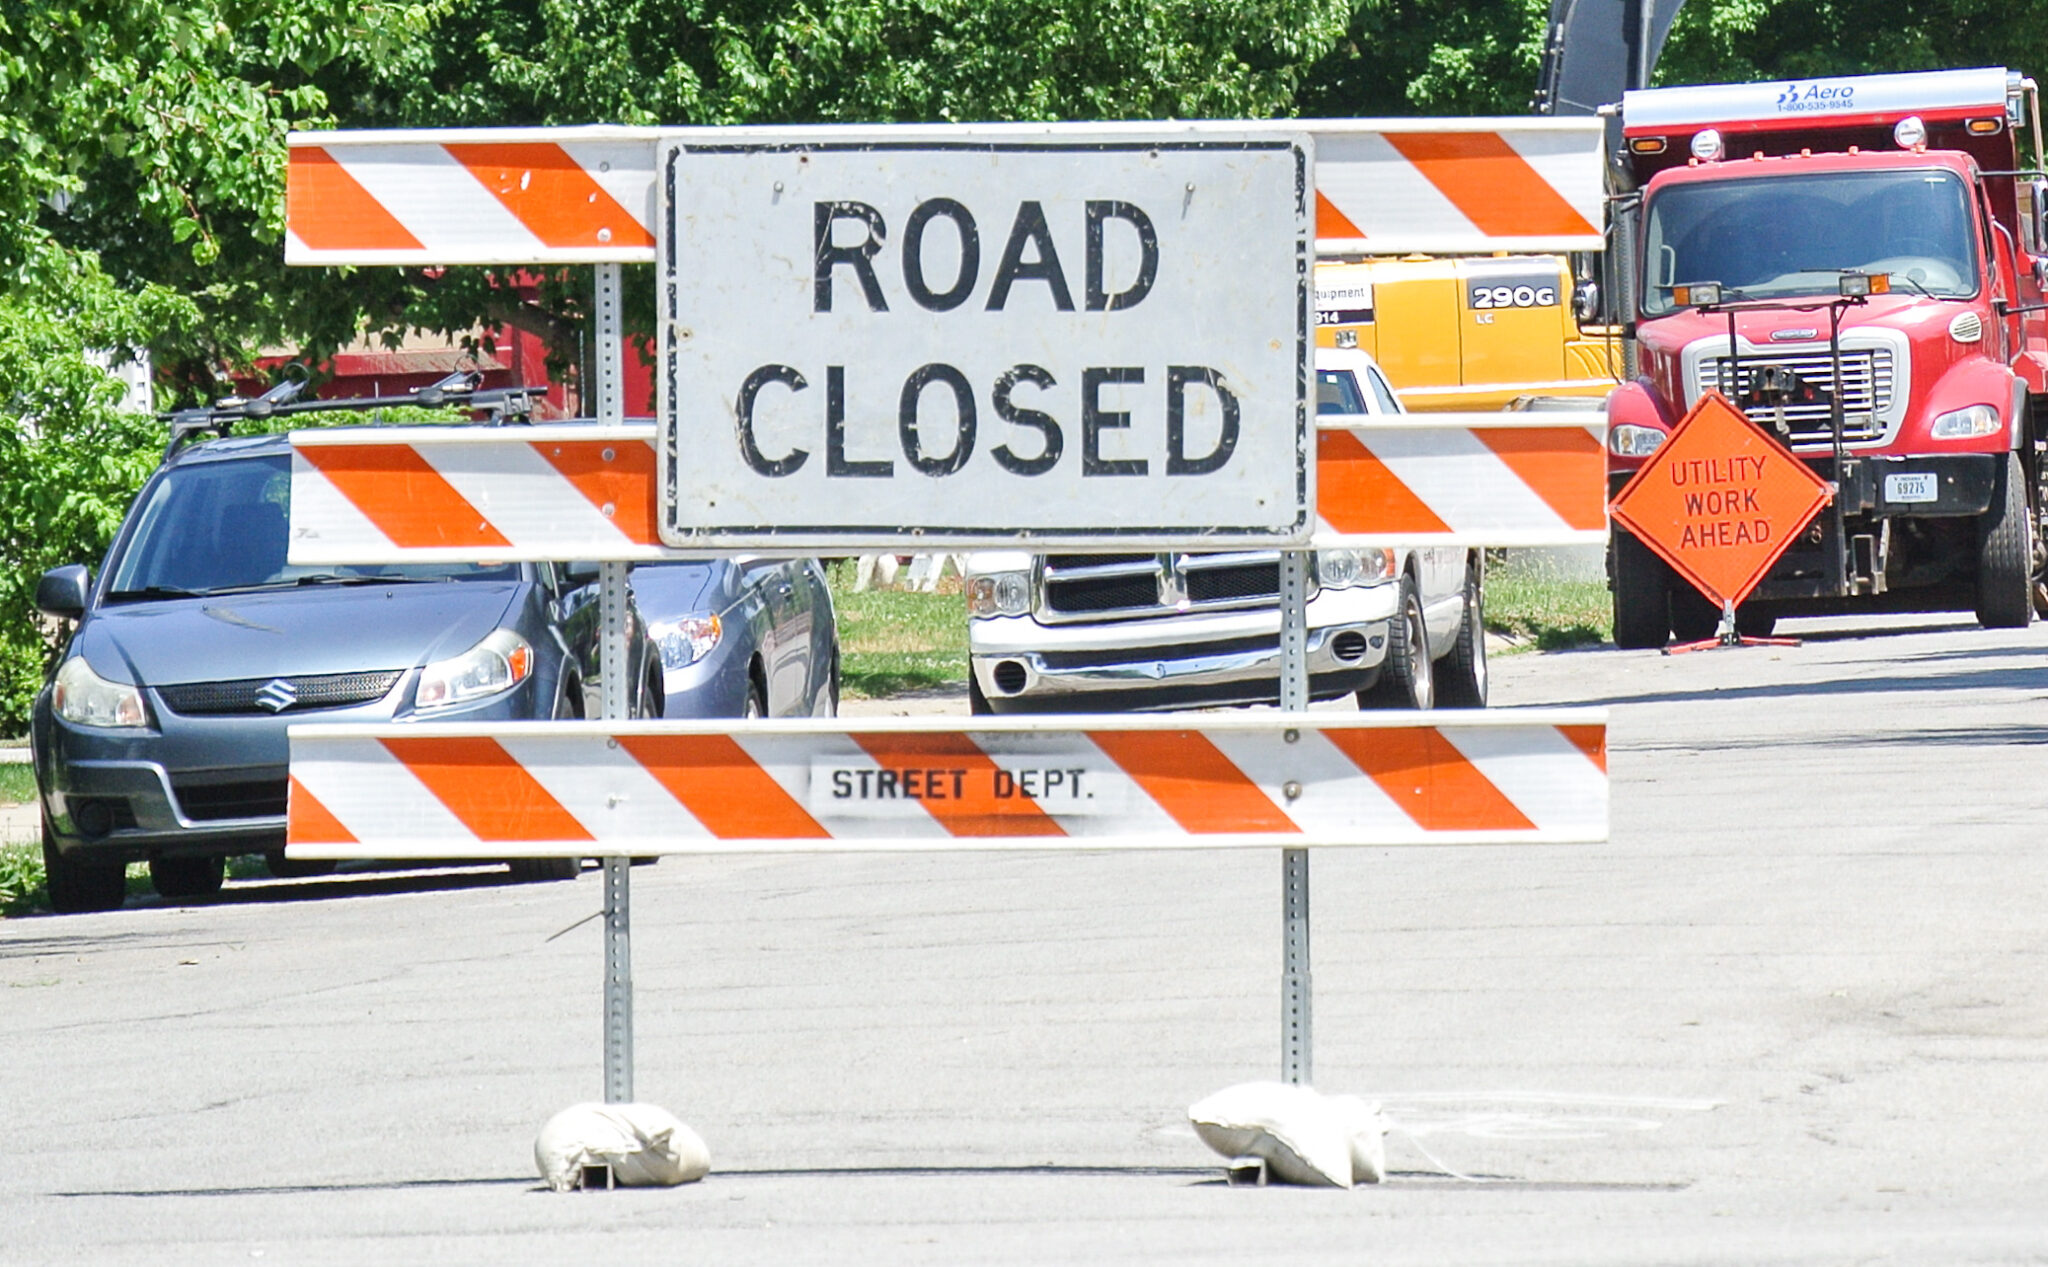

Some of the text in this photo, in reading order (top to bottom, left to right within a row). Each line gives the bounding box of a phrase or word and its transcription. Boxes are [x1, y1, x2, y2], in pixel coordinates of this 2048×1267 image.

[1804, 85, 1854, 99] Aero
[813, 197, 1160, 313] ROAD
[1473, 286, 1554, 309] 290G
[1476, 313, 1494, 325] LC
[734, 362, 1241, 479] CLOSED
[1671, 455, 1767, 487] UTILITY
[1685, 488, 1760, 517] WORK
[1897, 482, 1925, 494] 69275
[1681, 519, 1770, 550] AHEAD
[832, 769, 1093, 799] STREET DEPT.
